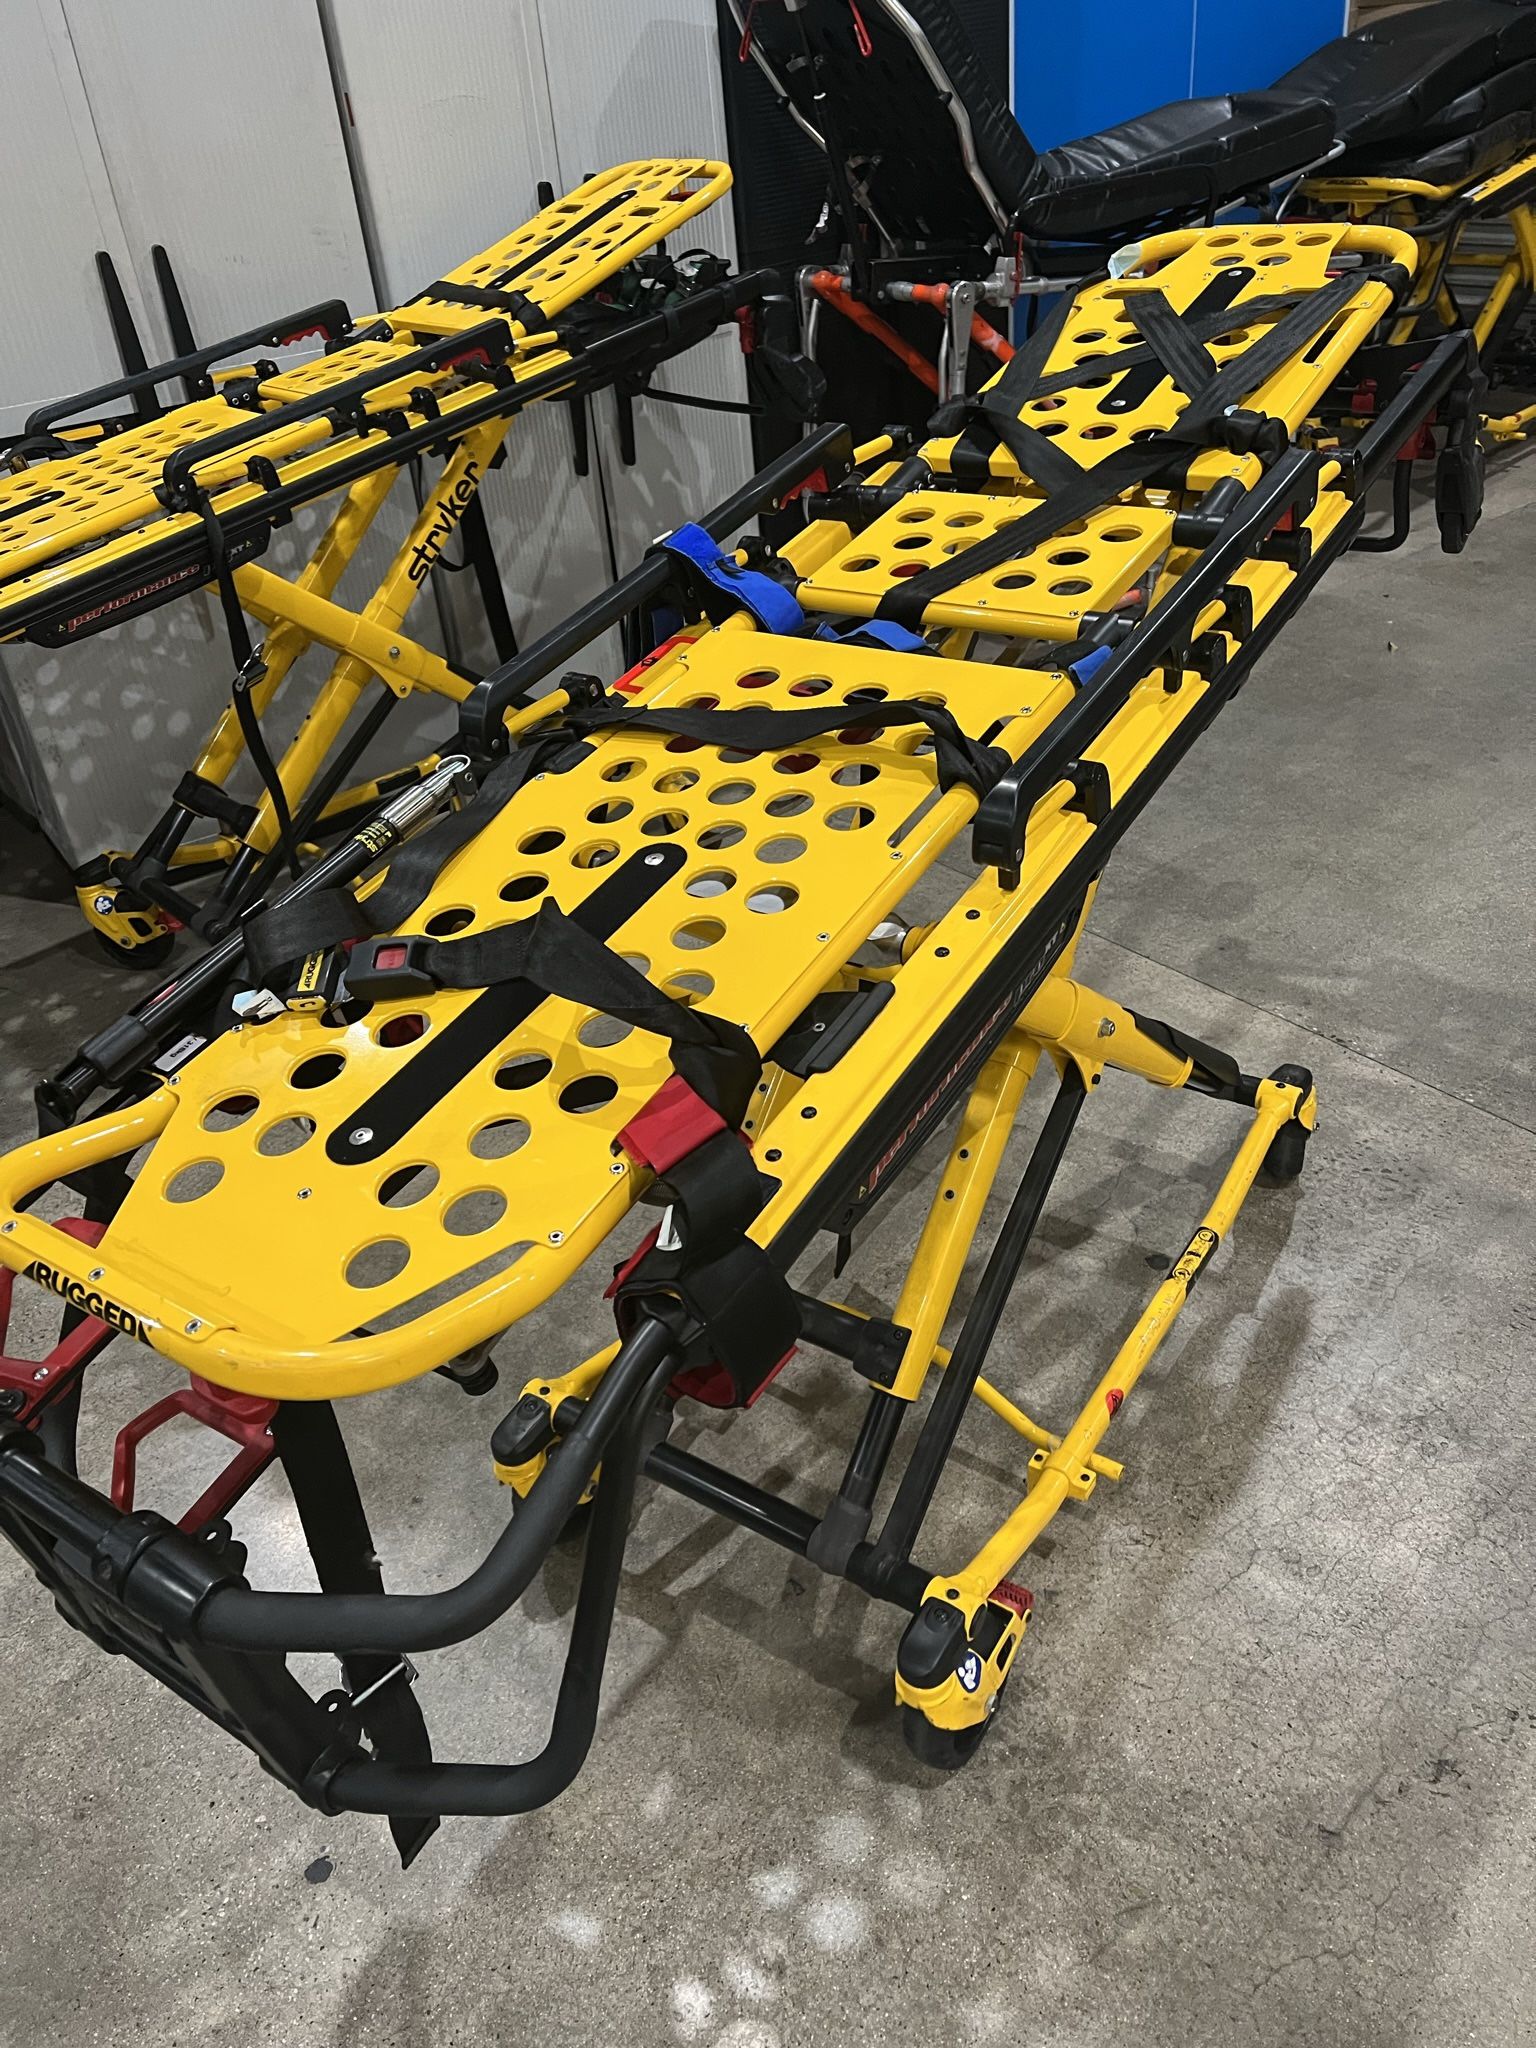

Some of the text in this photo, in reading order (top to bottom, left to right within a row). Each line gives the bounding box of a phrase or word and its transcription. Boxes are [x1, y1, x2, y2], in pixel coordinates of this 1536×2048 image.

[408, 461, 479, 590] stryker
[67, 564, 200, 632] performance
[304, 957, 317, 983] RUGG
[35, 1260, 137, 1337] RUGGED
